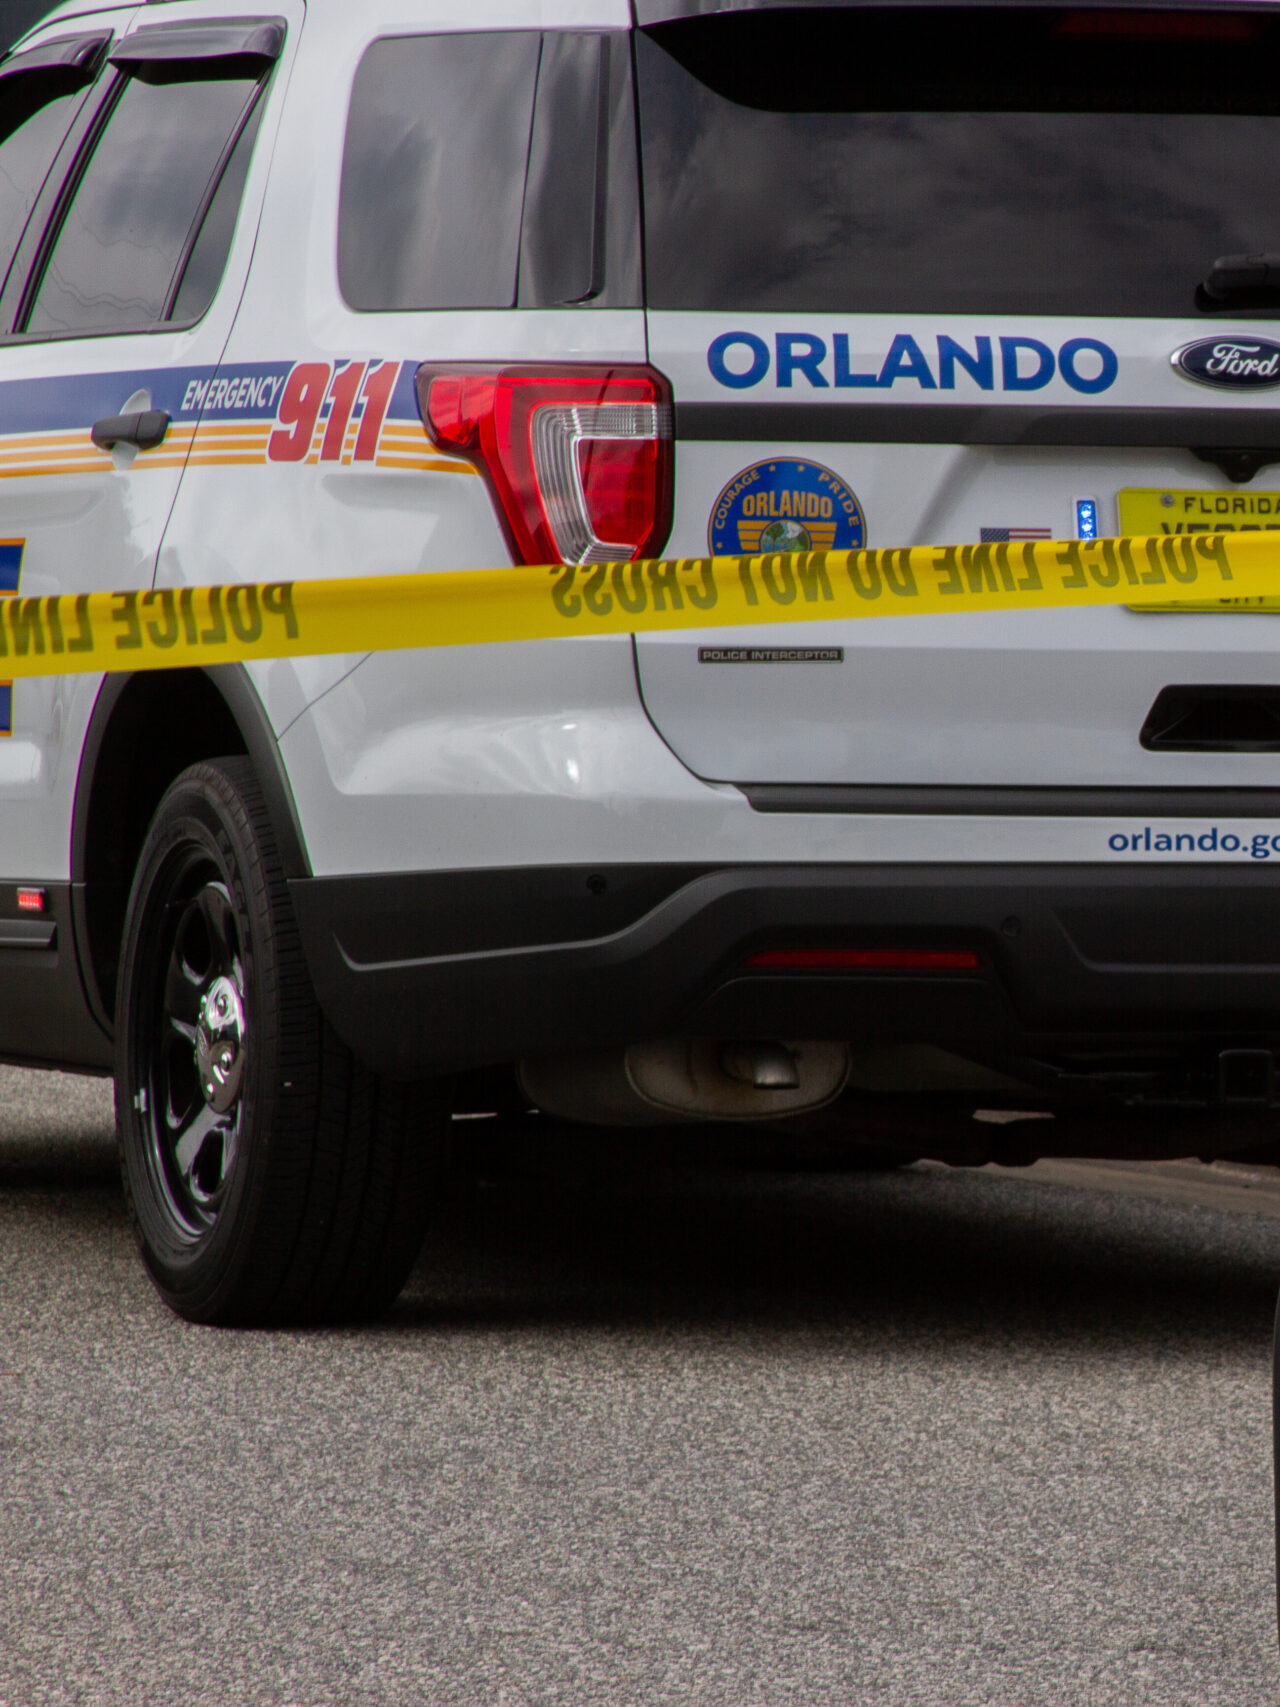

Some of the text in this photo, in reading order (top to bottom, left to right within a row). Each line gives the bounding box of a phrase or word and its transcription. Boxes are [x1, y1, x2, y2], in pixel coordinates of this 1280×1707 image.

[707, 331, 1119, 394] ORLANDO
[1206, 343, 1279, 377] Ford
[181, 361, 401, 463] EMERGENCY 911
[715, 470, 760, 529] COURAGE
[742, 490, 833, 518] ORLANDO
[818, 472, 859, 526] PRIDE
[703, 650, 838, 660] POLICE INTERCEPTOR
